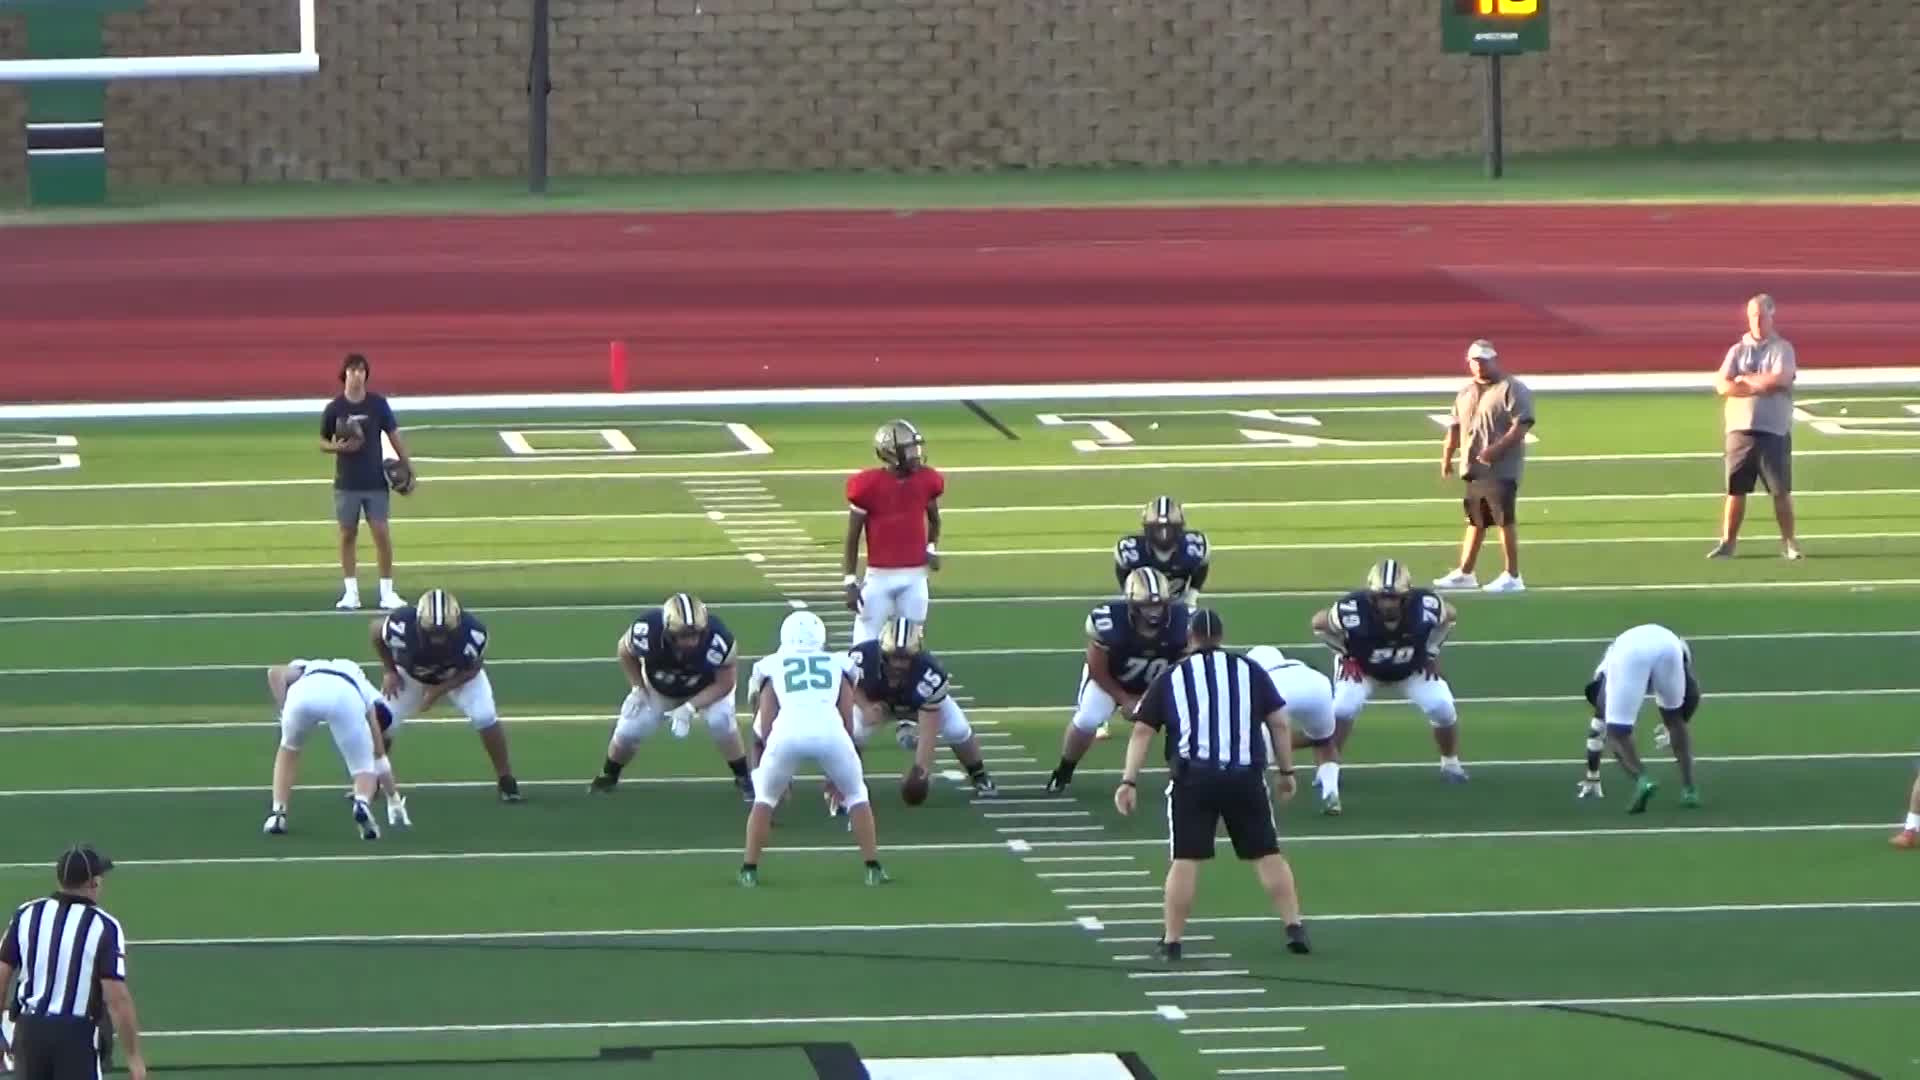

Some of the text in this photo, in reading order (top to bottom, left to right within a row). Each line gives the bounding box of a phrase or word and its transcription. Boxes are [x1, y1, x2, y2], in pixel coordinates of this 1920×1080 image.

[1119, 538, 1140, 562] 22
[1185, 533, 1205, 558] 22
[1092, 605, 1113, 631] 70
[1339, 599, 1361, 629] 79
[388, 620, 406, 651] 74
[463, 628, 486, 657] 74
[633, 622, 649, 651] 67
[706, 633, 729, 665] 67
[783, 656, 833, 693] 25
[916, 668, 942, 698] 65
[1117, 657, 1169, 687] 70
